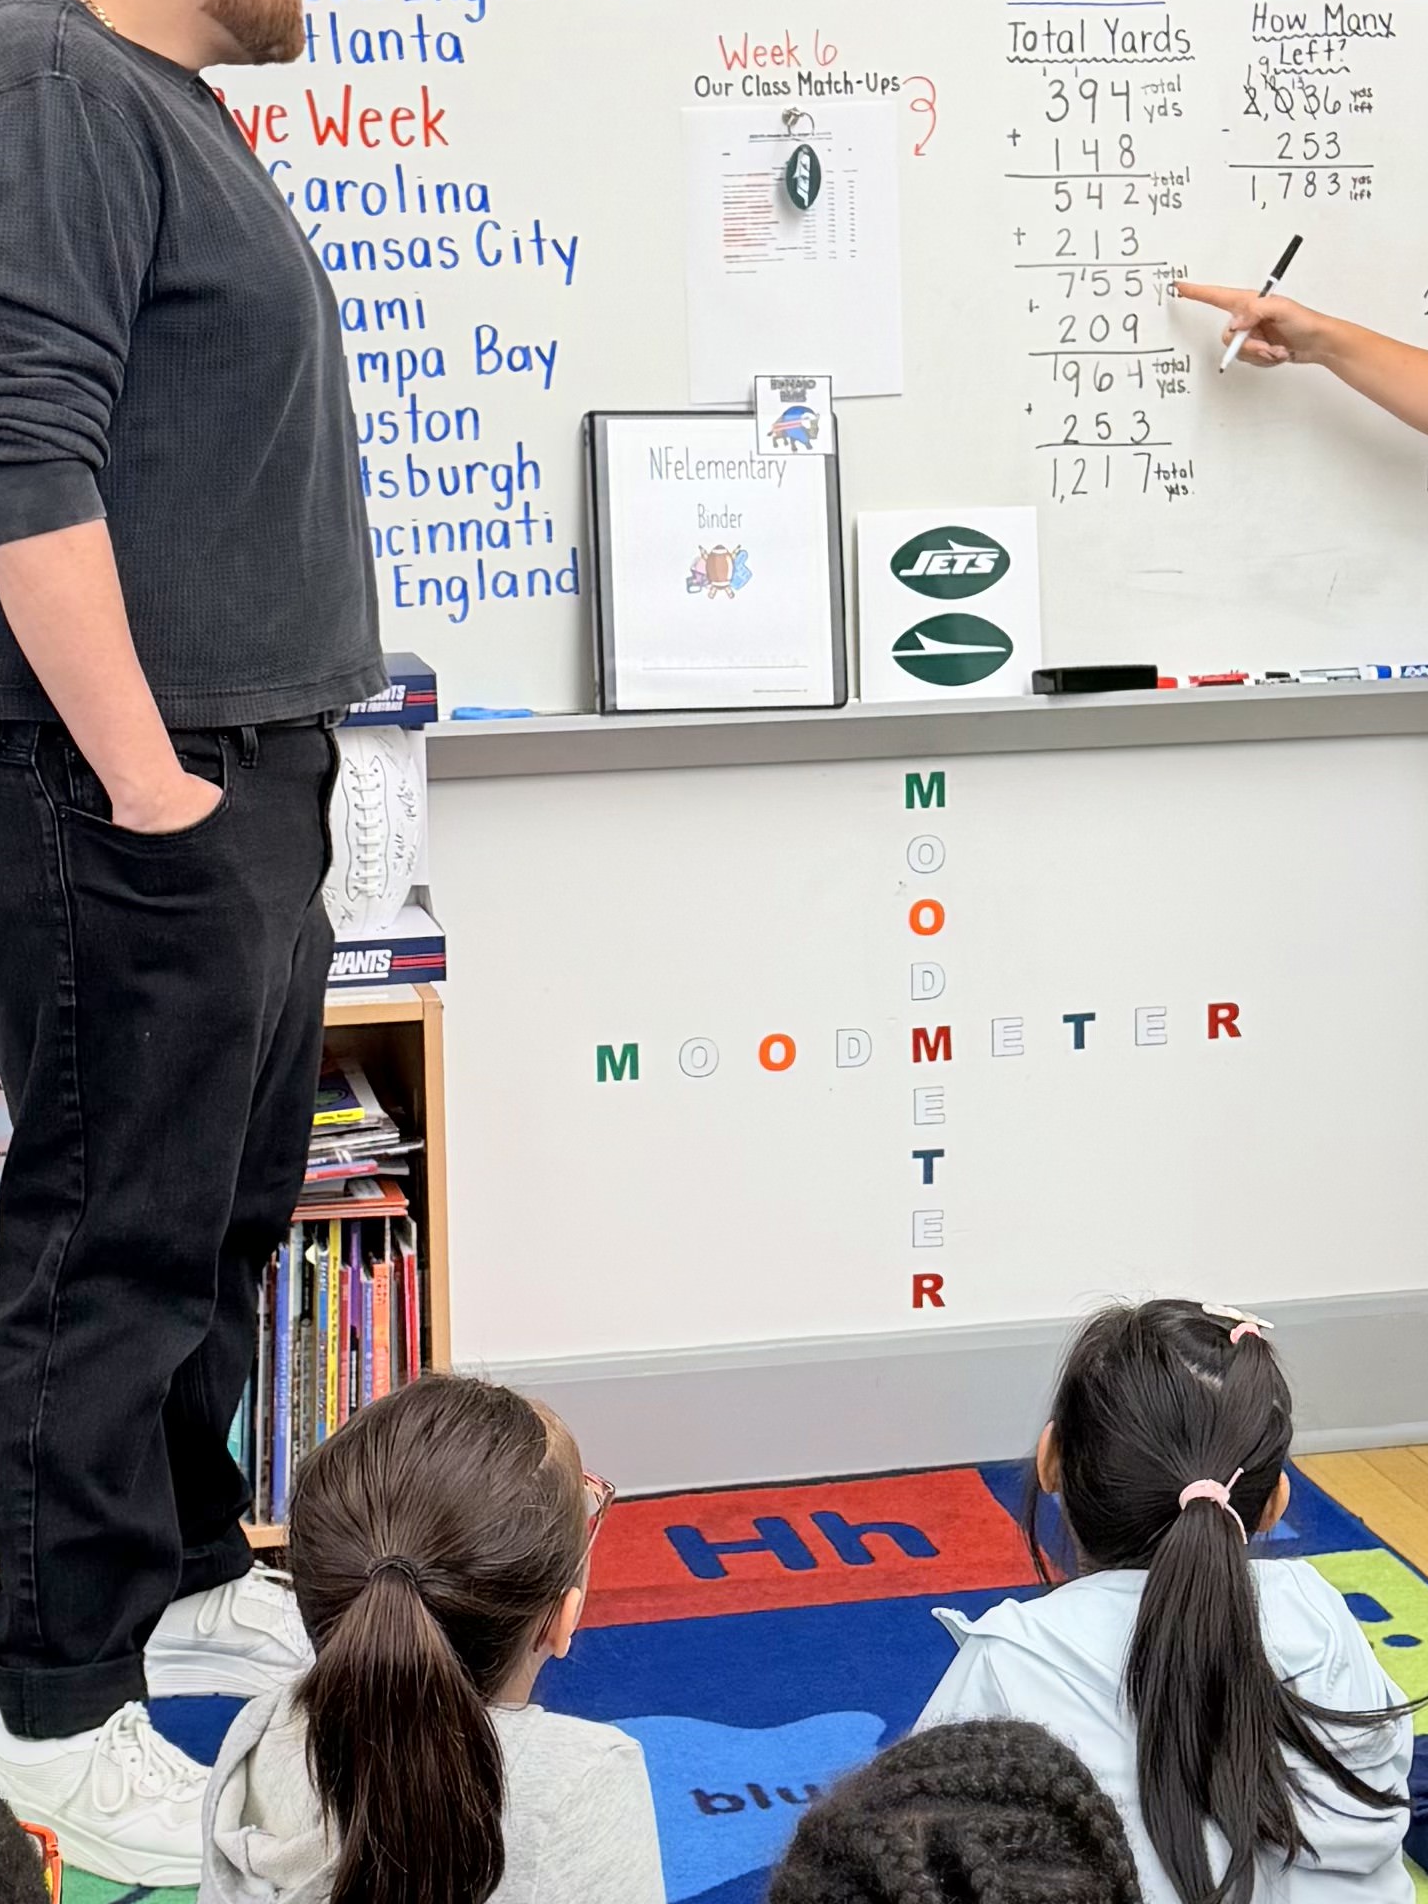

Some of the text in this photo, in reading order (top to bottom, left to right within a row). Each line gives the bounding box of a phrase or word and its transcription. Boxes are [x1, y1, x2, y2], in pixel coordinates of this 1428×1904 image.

[305, 10, 466, 67] tlanta
[1008, 15, 1192, 57] Total Yards
[1251, 2, 1393, 38] How Many
[718, 27, 839, 70] Week 6
[1278, 40, 1348, 67] Left?
[693, 72, 902, 103] Our Class Match-Ups
[1044, 77, 1131, 124] 394
[305, 84, 449, 149] Week
[1054, 132, 1137, 173] 148
[1276, 132, 1342, 161] 253
[1054, 180, 1141, 214] 542
[1249, 171, 1343, 212] 1,783
[476, 217, 580, 287] City
[1054, 226, 1140, 258] 213
[1058, 312, 1141, 345] 209
[474, 323, 558, 391] Bay
[1062, 409, 1152, 445] 253
[647, 446, 788, 489] NFeLementary
[1051, 452, 1153, 504] 1,217
[696, 502, 744, 530] Binder
[898, 539, 1000, 578] JETS
[392, 546, 581, 624] England
[662, 1507, 942, 1580] Hh
